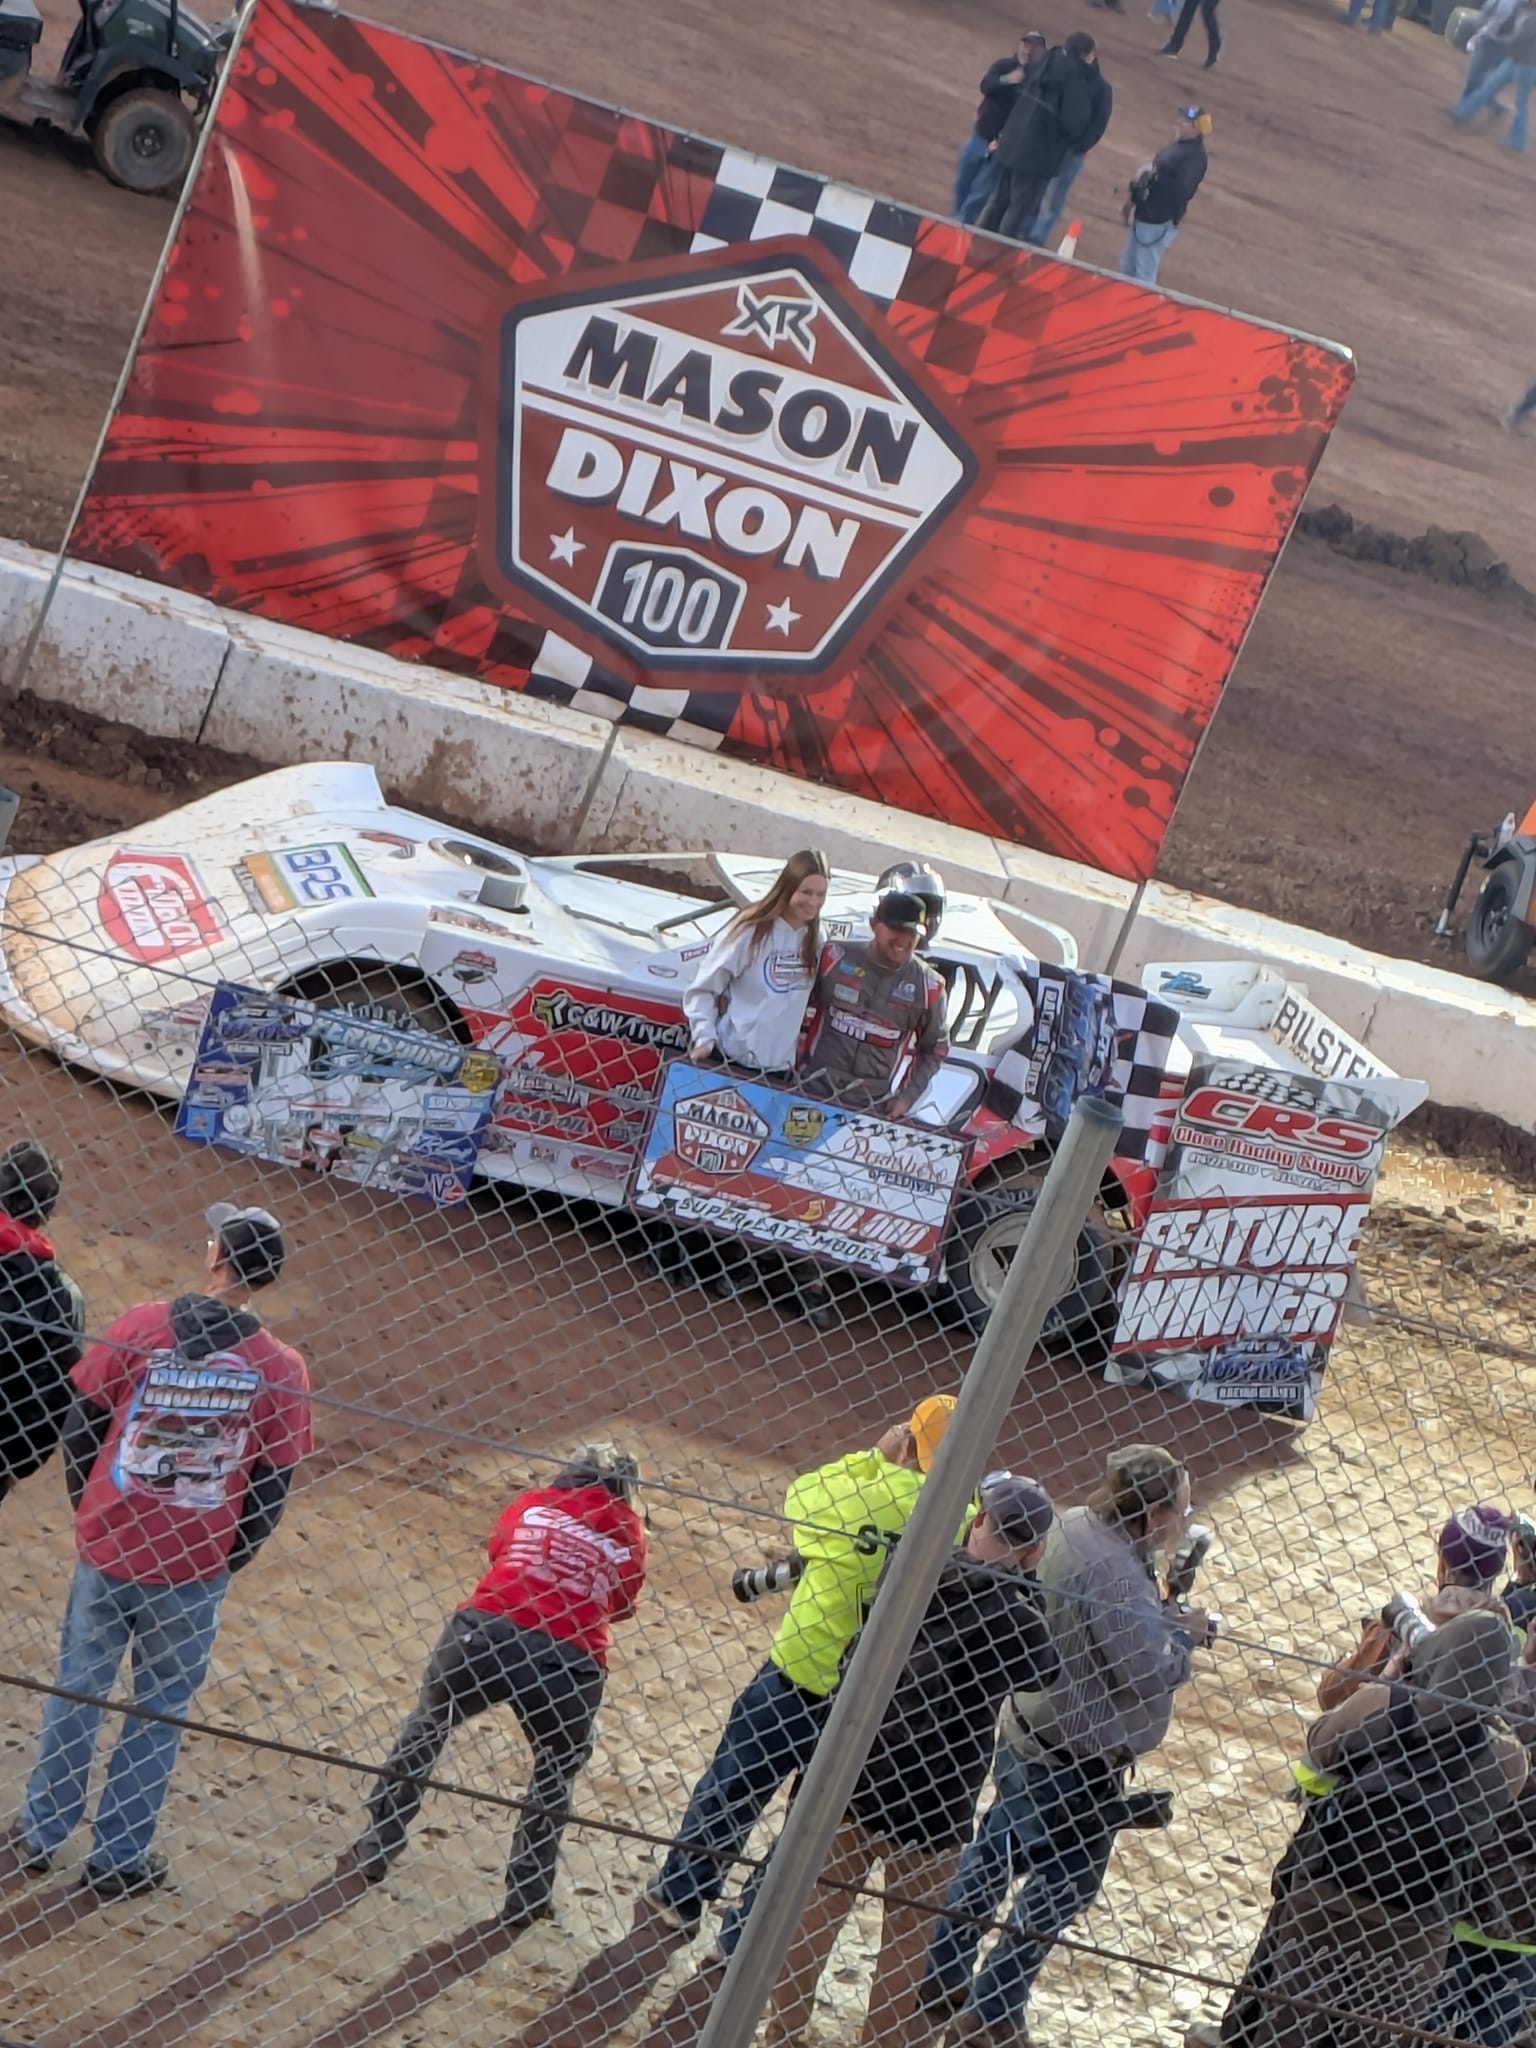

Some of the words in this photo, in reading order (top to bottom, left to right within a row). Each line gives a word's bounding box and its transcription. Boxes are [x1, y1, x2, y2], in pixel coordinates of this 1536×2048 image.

[721, 283, 818, 364] XR
[562, 315, 921, 488] MASON
[545, 426, 861, 579] DIXON
[621, 559, 722, 644] 100
[284, 848, 352, 901] BRS
[1272, 995, 1387, 1081] BILSTE
[1181, 1087, 1385, 1158] CRS
[1133, 1202, 1370, 1275] FEATURE
[1113, 1270, 1350, 1344] WINNER
